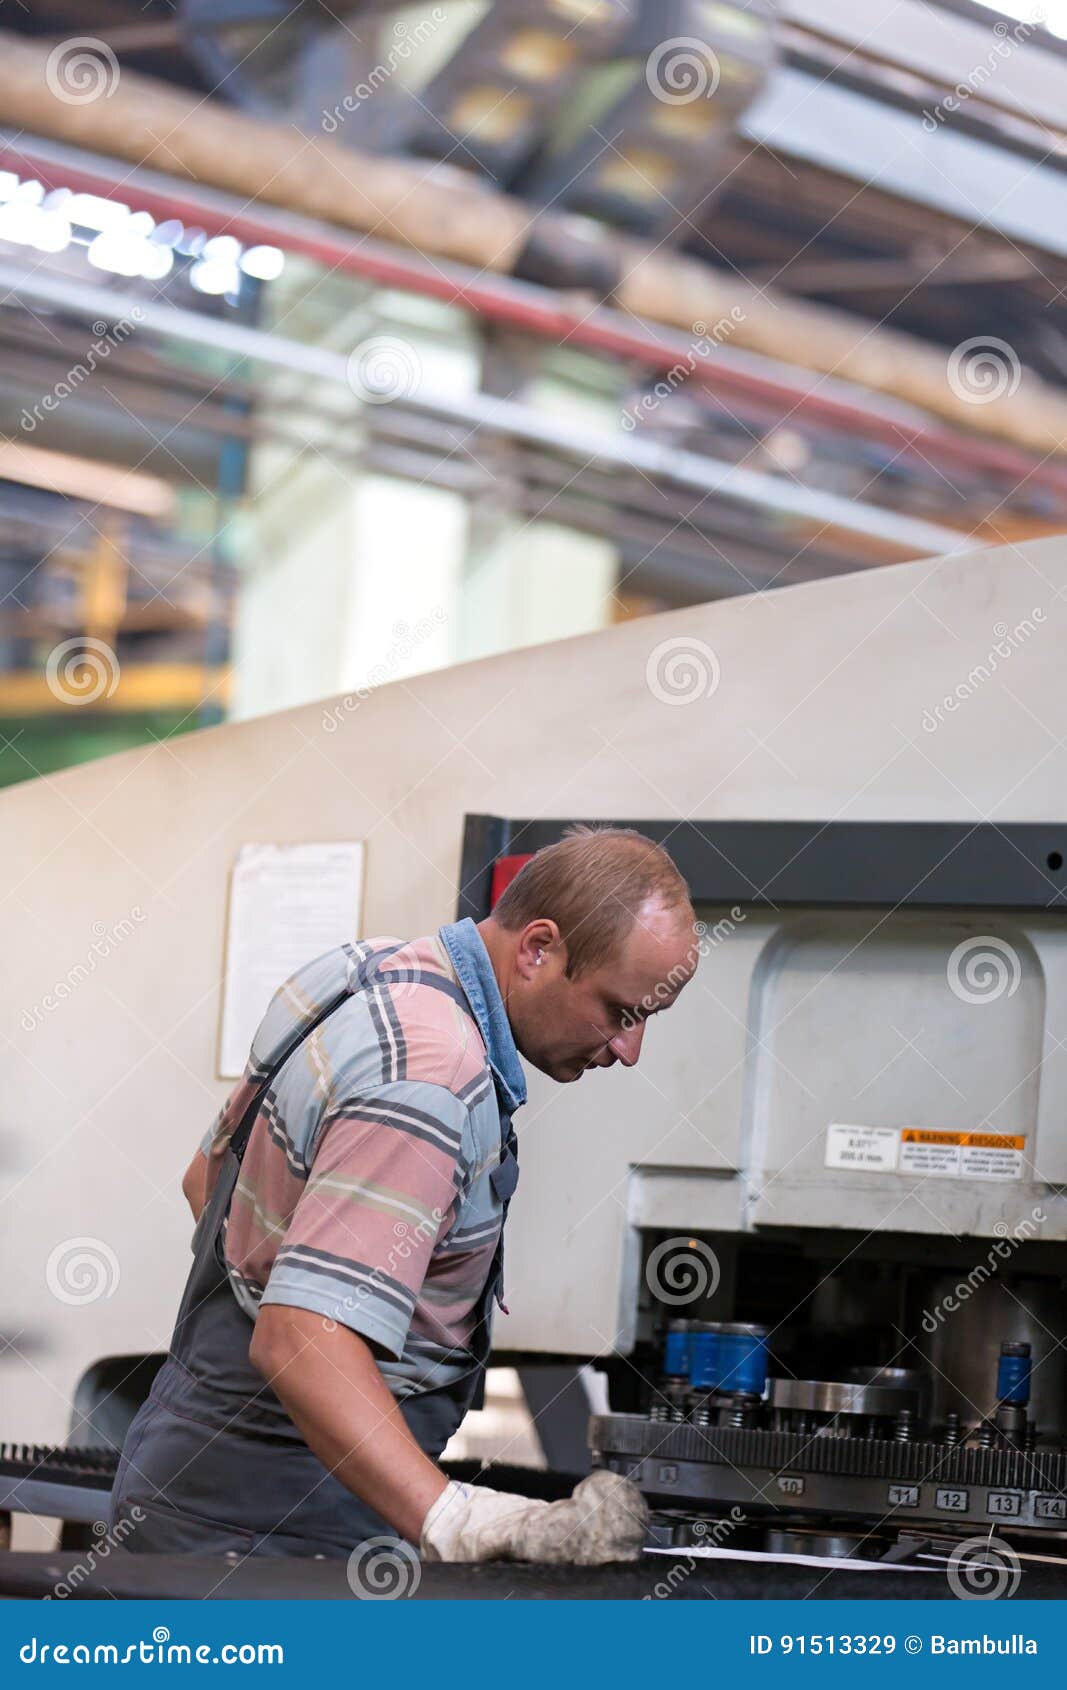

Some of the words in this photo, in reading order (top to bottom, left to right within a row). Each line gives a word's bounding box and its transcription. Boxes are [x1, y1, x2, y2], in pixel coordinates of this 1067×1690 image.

[782, 1480, 798, 1494] 10
[894, 1489, 911, 1503] 11
[943, 1493, 961, 1508] 12
[994, 1496, 1013, 1512] 13
[1042, 1501, 1060, 1516] 14
